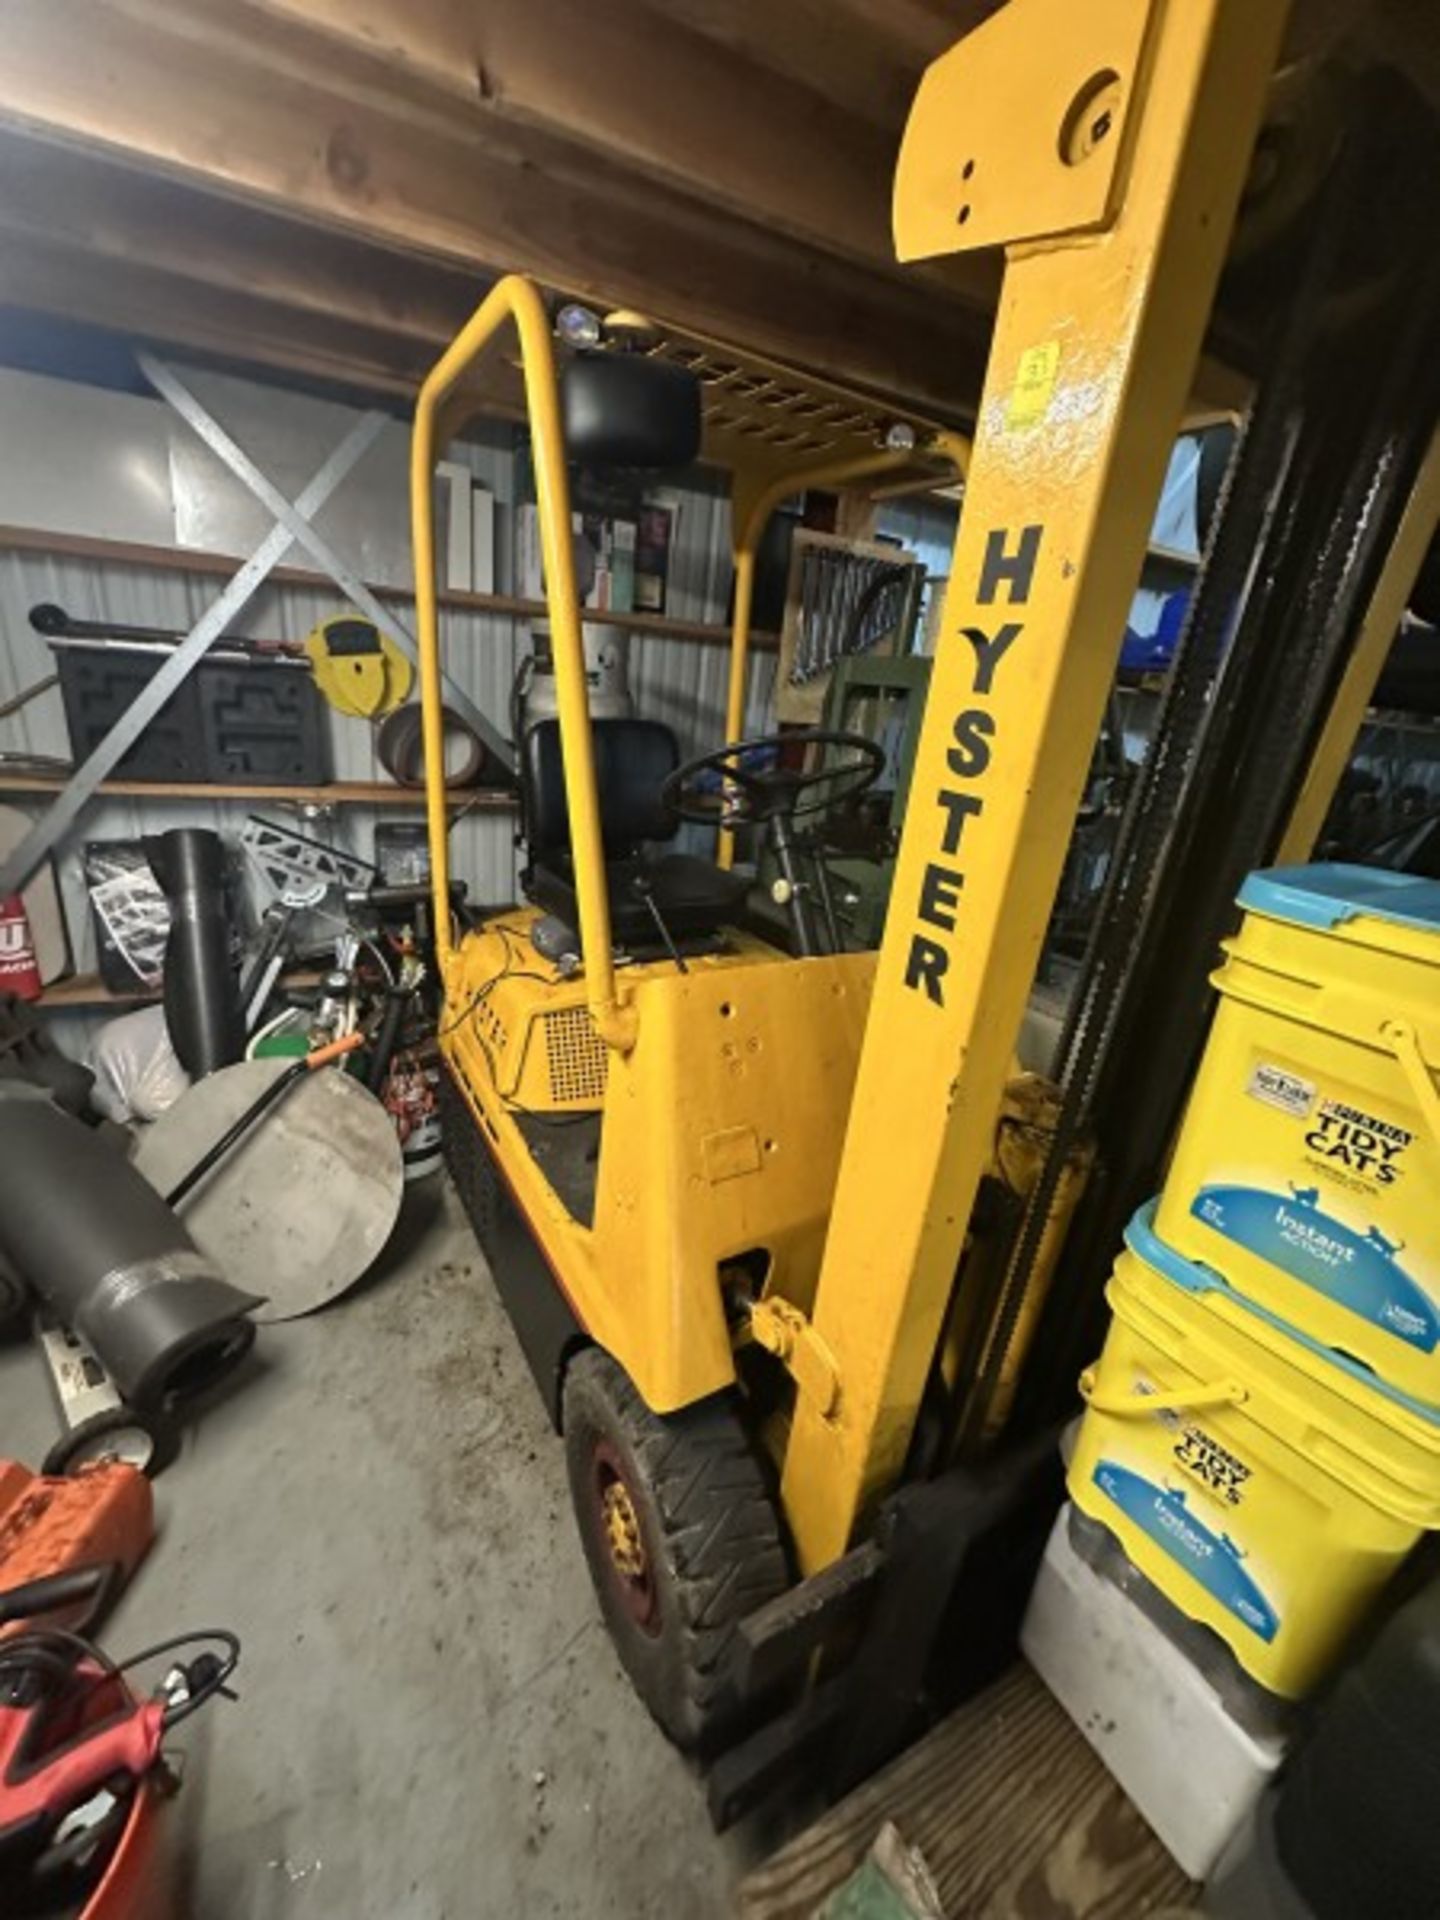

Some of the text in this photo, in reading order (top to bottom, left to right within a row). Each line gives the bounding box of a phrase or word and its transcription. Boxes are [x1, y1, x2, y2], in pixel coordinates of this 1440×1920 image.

[904, 525, 1044, 1008] HYSTER
[1304, 1132, 1396, 1184] CATS
[1317, 1112, 1404, 1161] TIDY
[1275, 1206, 1356, 1262] Instant
